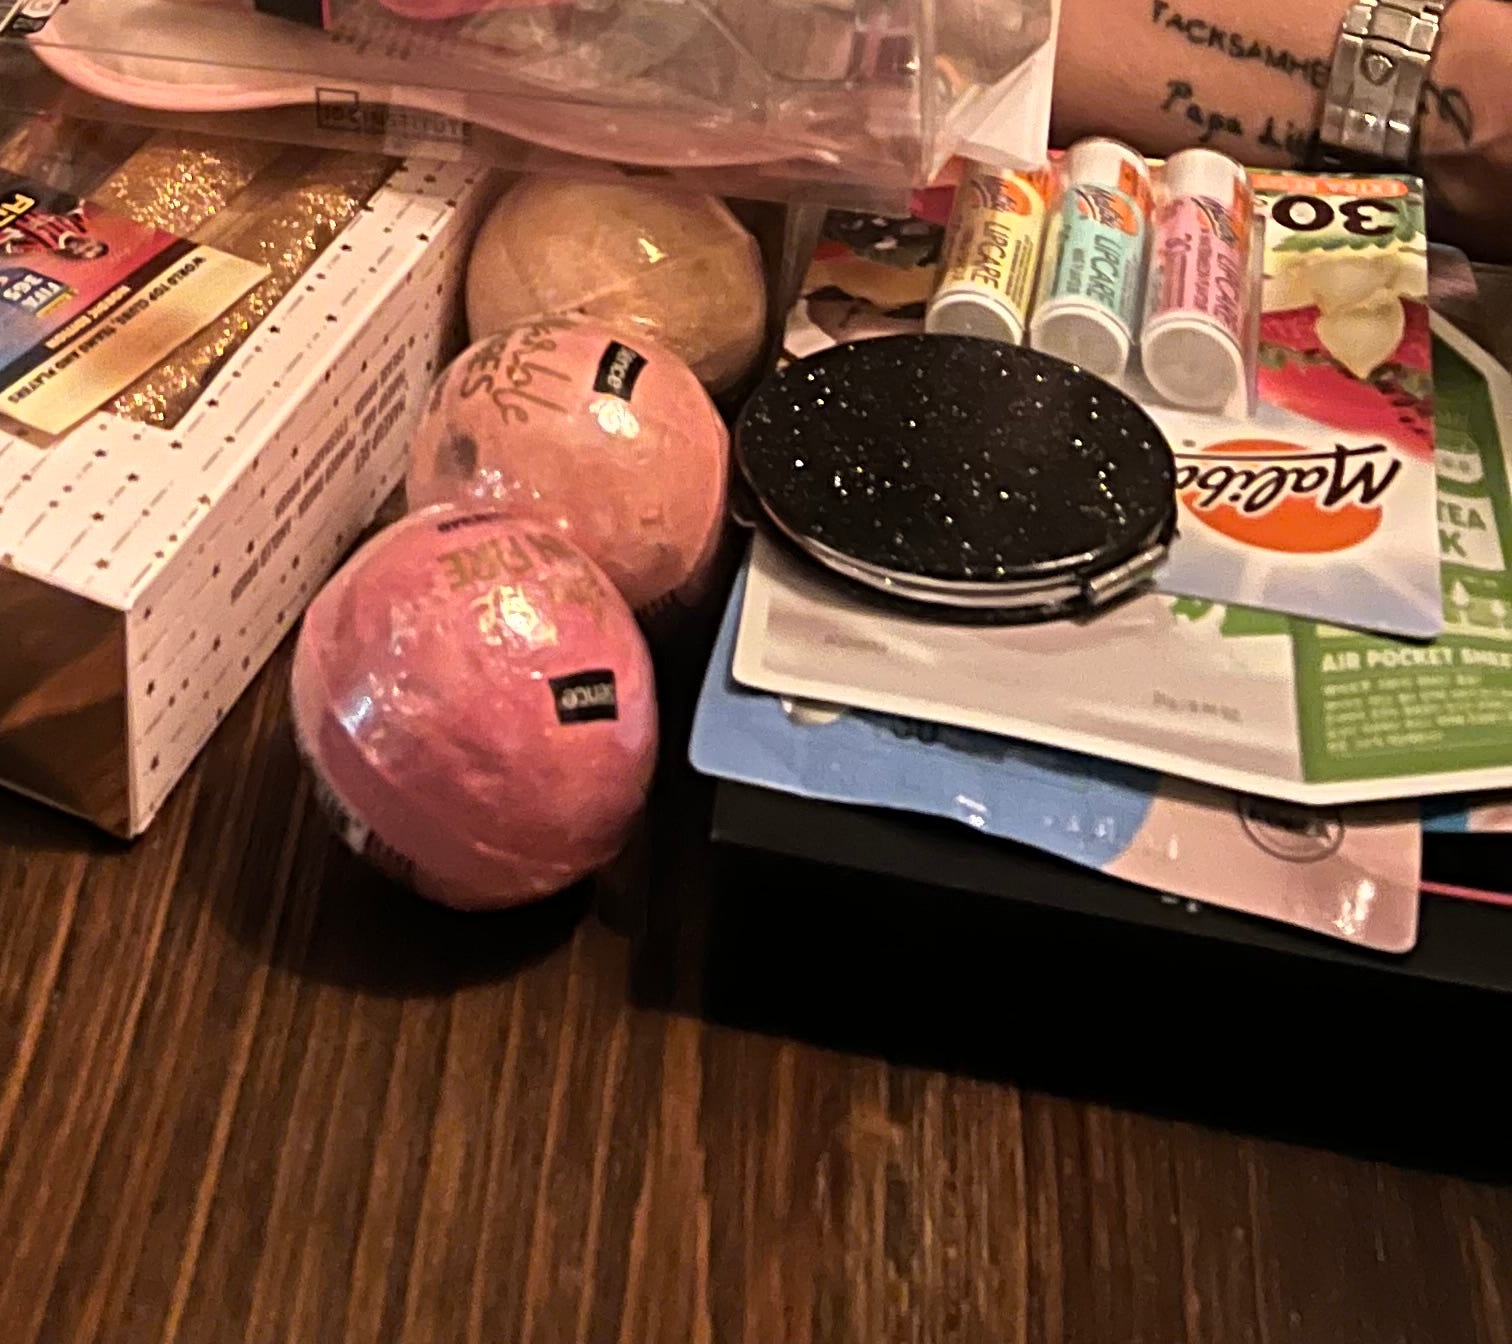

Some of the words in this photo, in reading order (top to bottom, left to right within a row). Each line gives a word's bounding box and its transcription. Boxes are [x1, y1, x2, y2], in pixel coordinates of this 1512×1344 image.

[1159, 78, 1245, 144] Papa
[1271, 193, 1401, 237] 30
[168, 254, 207, 288] WORLD
[970, 220, 1011, 290] LIPCARE
[1085, 233, 1123, 315] LIPCARE
[148, 281, 171, 303] TOP
[7, 367, 57, 404] PLAYERS
[1321, 652, 1362, 673] AIR
